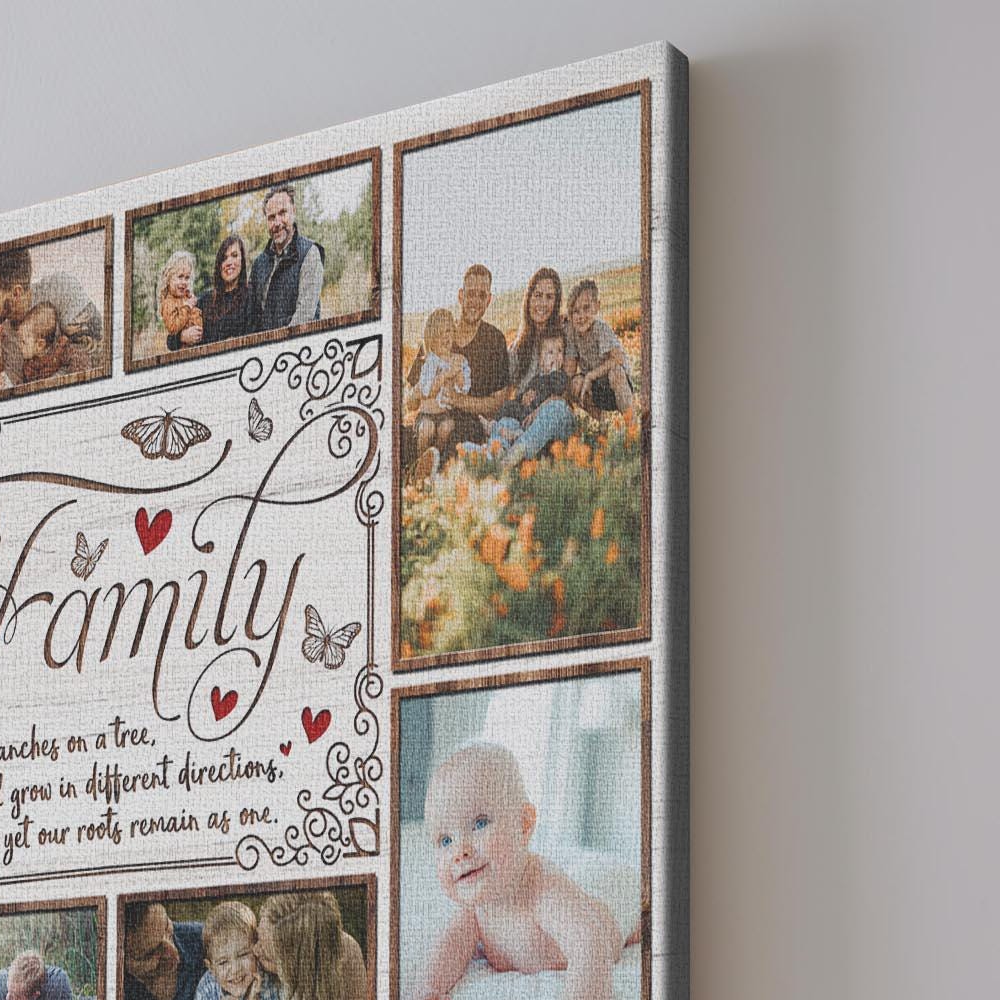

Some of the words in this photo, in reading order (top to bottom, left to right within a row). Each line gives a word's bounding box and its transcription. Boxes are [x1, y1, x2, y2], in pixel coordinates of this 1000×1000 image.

[67, 735, 88, 754] on
[95, 732, 107, 750] a
[109, 715, 156, 749] tree,
[10, 782, 52, 819] grow
[59, 776, 78, 799] in
[85, 754, 174, 805] different
[177, 746, 284, 792] directions,
[2, 815, 34, 866] yet
[37, 826, 71, 846] our
[77, 806, 123, 845] roots
[130, 808, 200, 839] remain
[207, 809, 232, 834] as
[239, 806, 280, 828] one.
